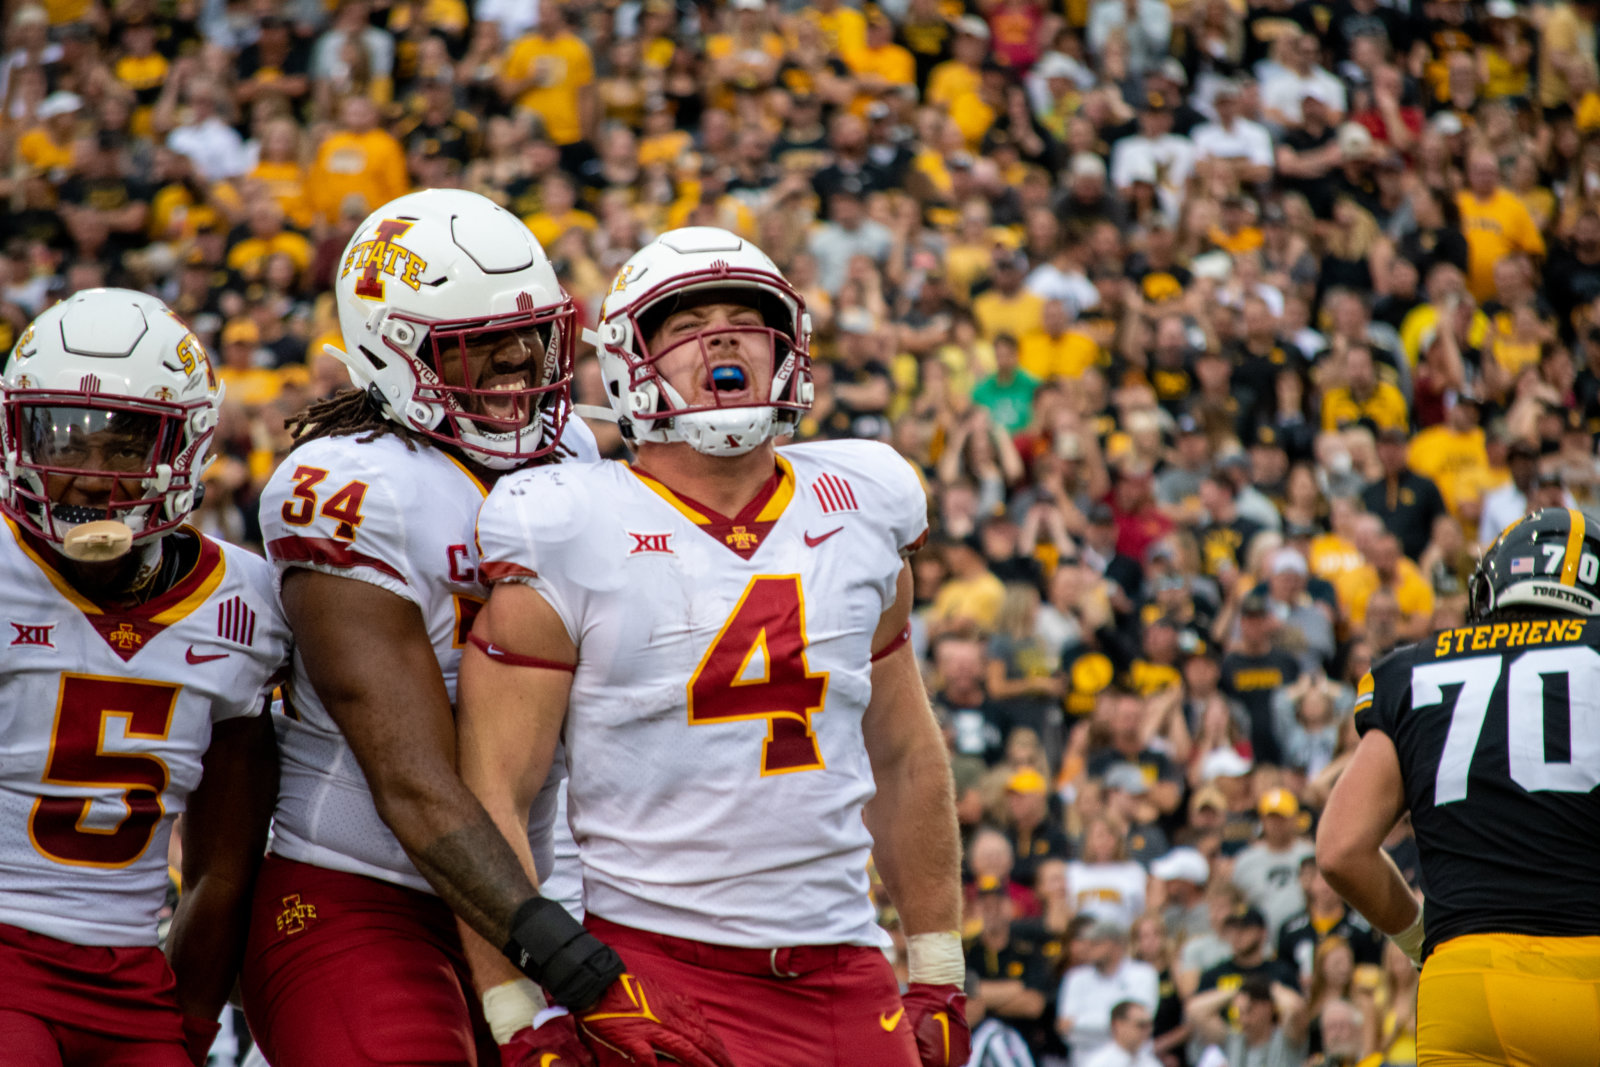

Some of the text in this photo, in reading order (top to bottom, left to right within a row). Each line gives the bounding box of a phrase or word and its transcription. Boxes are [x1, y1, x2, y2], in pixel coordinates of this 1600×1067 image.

[341, 240, 428, 292] STATE
[281, 464, 369, 542] 34
[628, 532, 674, 554] XII
[726, 533, 758, 544] STATE
[446, 544, 476, 583] C
[1542, 543, 1600, 586] 70
[1533, 585, 1593, 612] TOGETHER
[10, 622, 54, 648] XII
[110, 630, 142, 644] STATE
[1435, 619, 1588, 658] STEPHENS
[686, 573, 830, 778] 4
[1411, 645, 1600, 807] 70
[28, 671, 184, 869] 5
[276, 904, 317, 931] STATE
